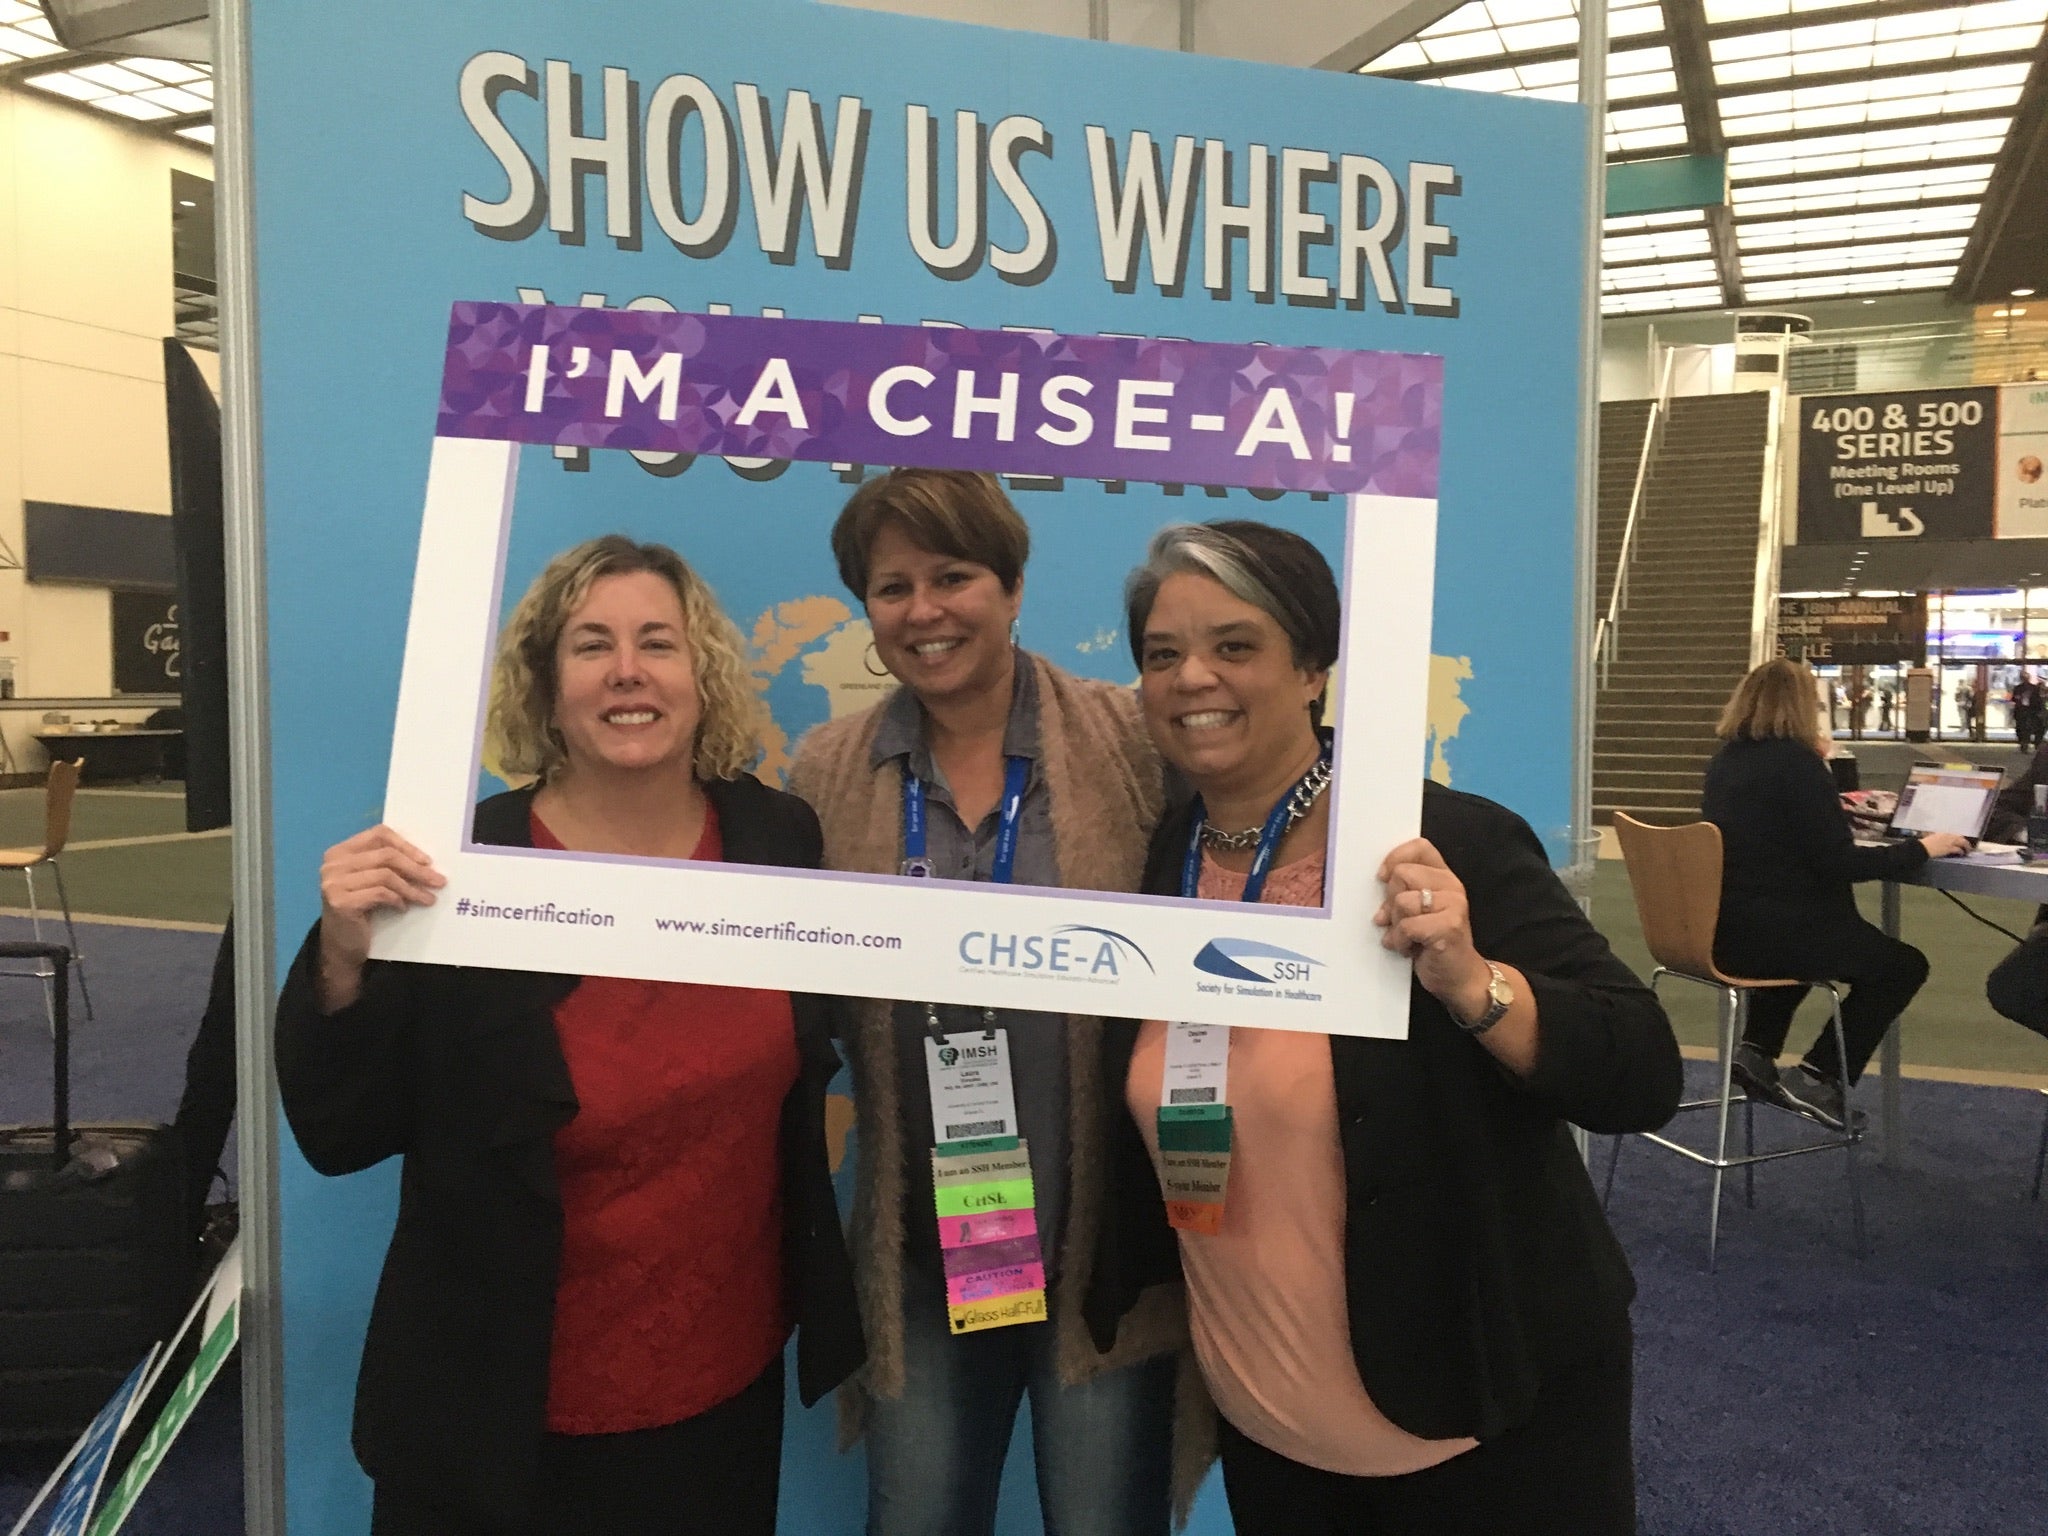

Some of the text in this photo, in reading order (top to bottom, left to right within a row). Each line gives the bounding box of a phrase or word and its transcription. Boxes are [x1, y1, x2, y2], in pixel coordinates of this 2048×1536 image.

[457, 50, 1462, 318] SHOW US WHERE
[524, 344, 1355, 463] I'M A CHSE-A!
[1811, 400, 1983, 433] 400 & 500
[1836, 430, 1955, 460] SERIES
[1830, 462, 1961, 480] Meeting Rooms
[1834, 478, 1955, 498] (One Level Up)
[1838, 601, 1902, 613] ANNUAL
[455, 896, 616, 928] #simcertification
[655, 914, 903, 950] www.simcertification.com
[958, 930, 1120, 976] CHSE-A
[1273, 961, 1310, 982] SSH
[1196, 982, 1322, 1001] Society for Simulation in Healthcare
[961, 1045, 998, 1059] IMSH
[992, 1161, 1026, 1170] Member
[966, 1268, 1023, 1284] CAUTION
[966, 1308, 1000, 1324] Glass
